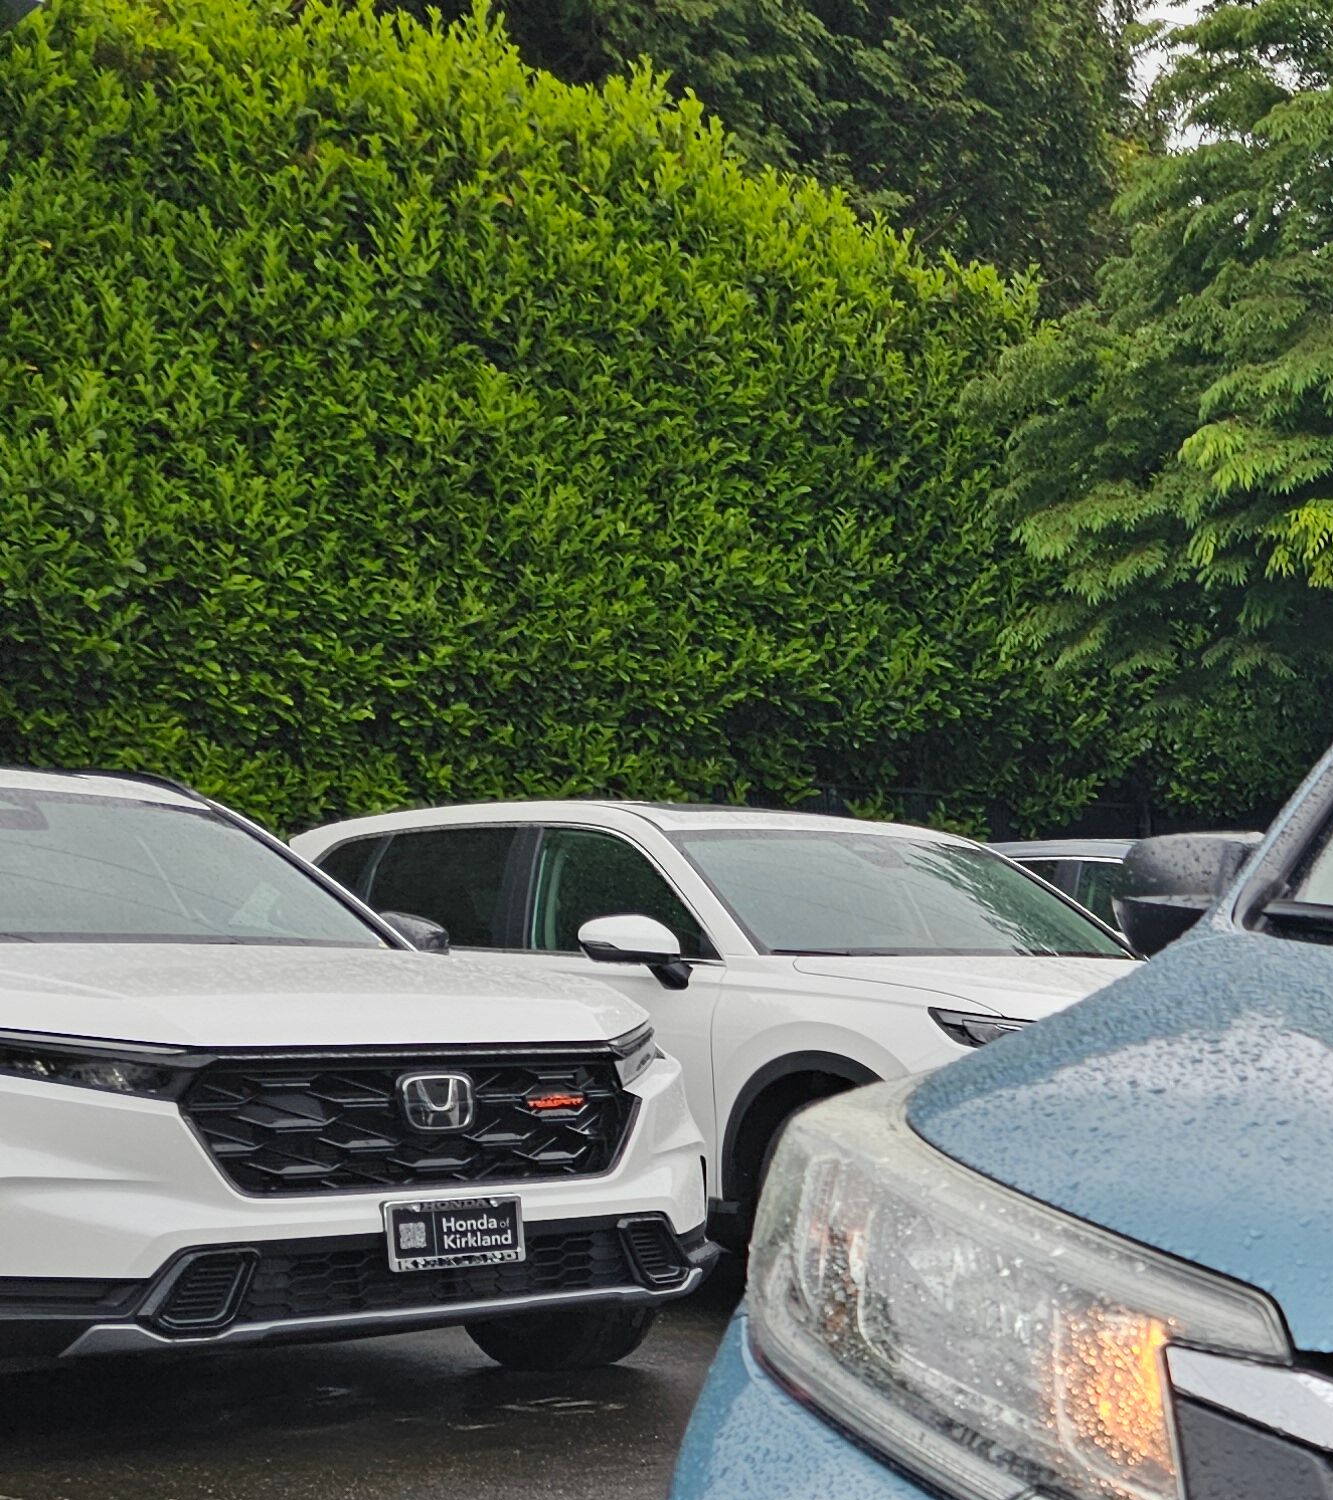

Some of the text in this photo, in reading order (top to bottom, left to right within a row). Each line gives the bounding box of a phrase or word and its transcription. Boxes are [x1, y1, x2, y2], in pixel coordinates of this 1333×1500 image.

[442, 1213, 511, 1233] Honda of
[443, 1229, 513, 1250] Kirkland
